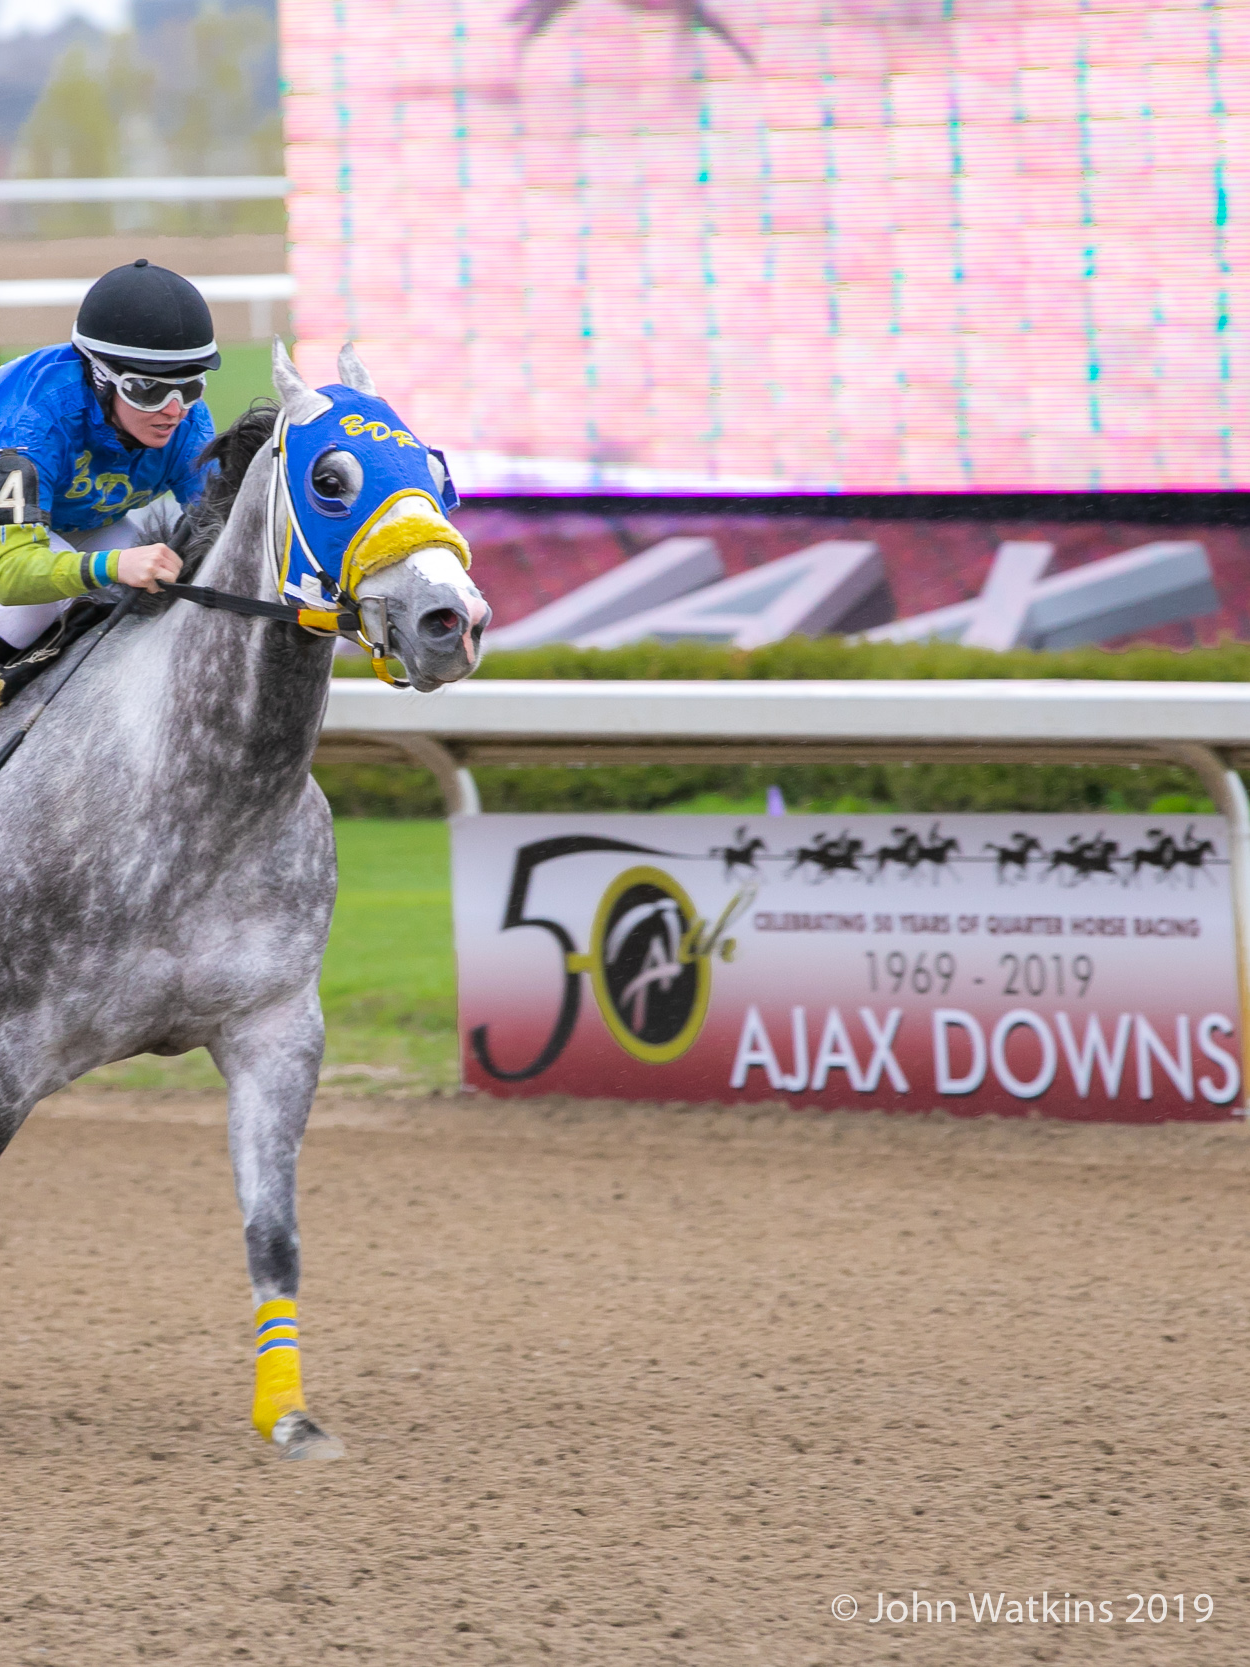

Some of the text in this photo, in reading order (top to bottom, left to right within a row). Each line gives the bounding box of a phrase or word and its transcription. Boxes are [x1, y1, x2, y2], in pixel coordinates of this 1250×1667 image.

[339, 414, 420, 448] BDR
[754, 912, 867, 933] CELEBRATING
[900, 914, 950, 934] YEARS
[957, 915, 980, 934] OF
[987, 916, 1063, 936] QUARTER
[1071, 916, 1127, 937] HORSE
[1134, 917, 1199, 939] RACING
[865, 951, 955, 995] 1969
[999, 953, 1095, 998] 2019
[729, 1006, 1240, 1104] AJAX DOWNS
